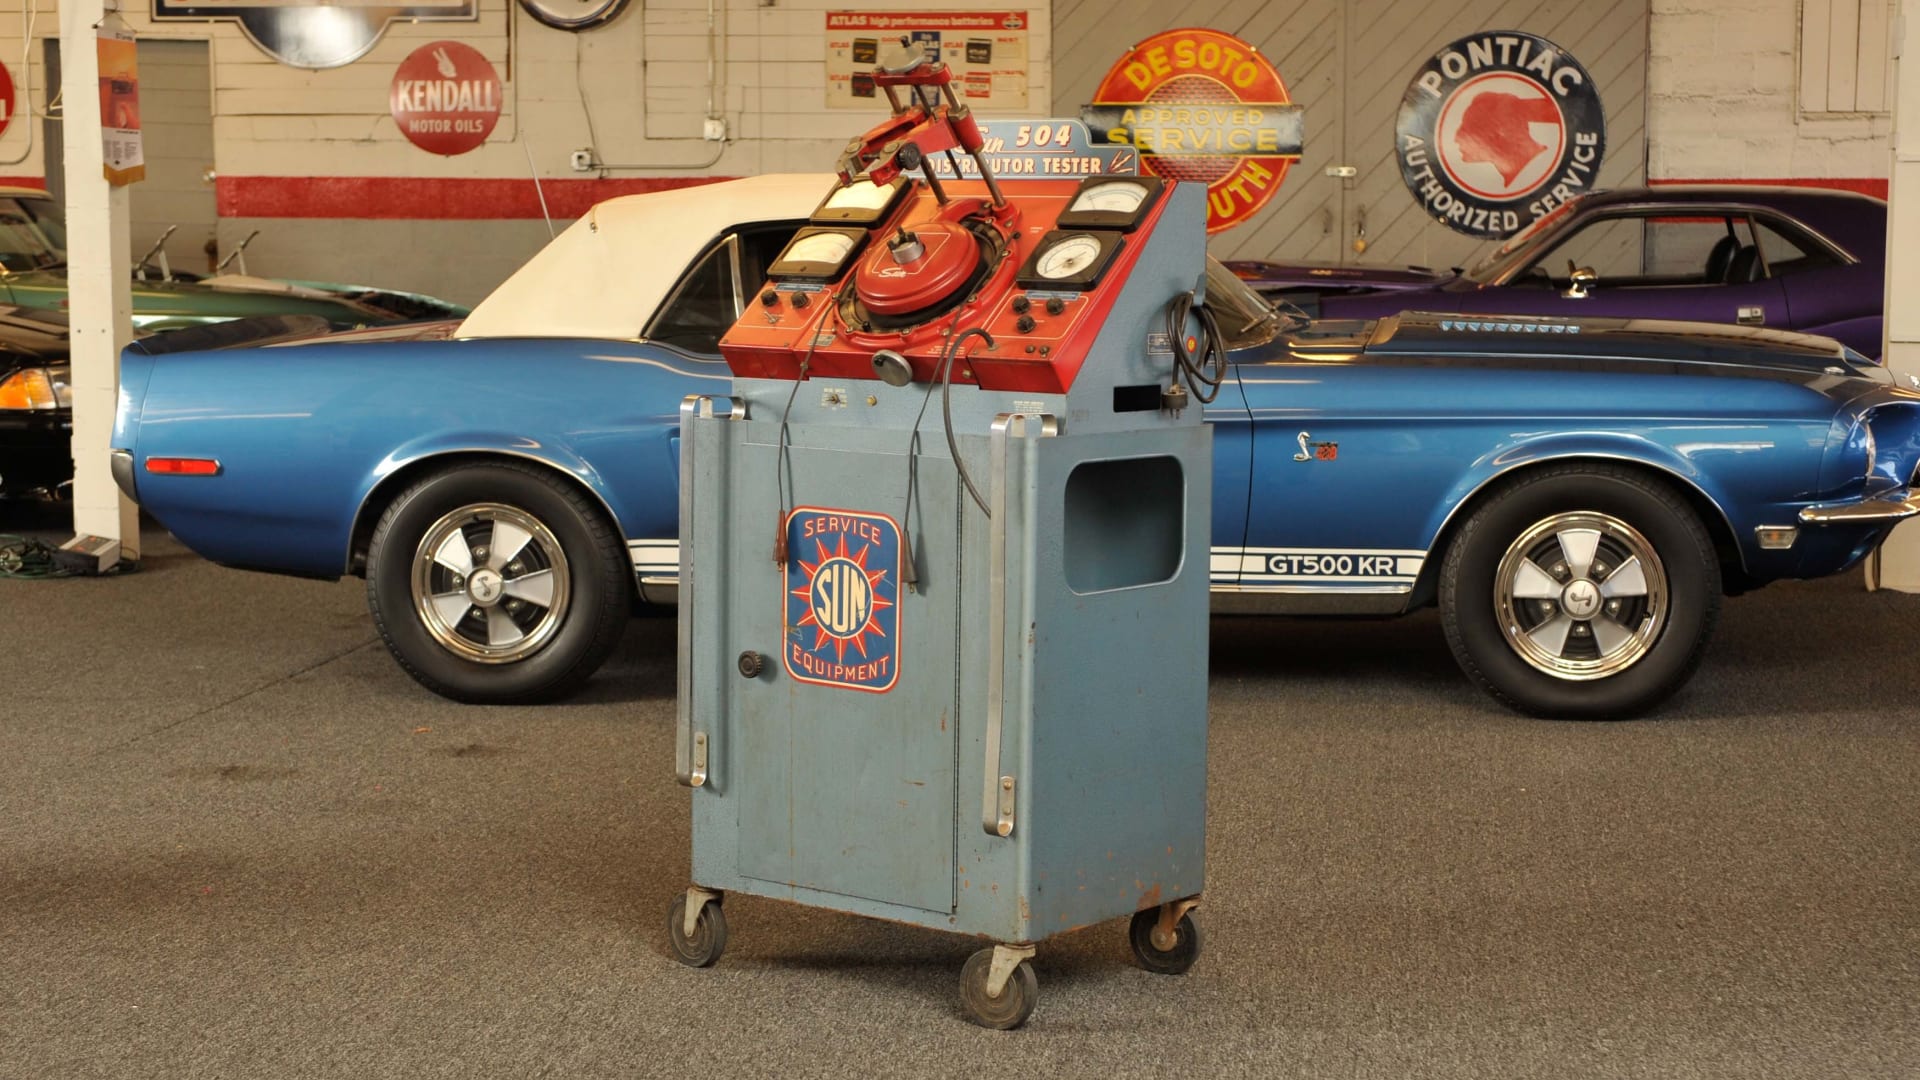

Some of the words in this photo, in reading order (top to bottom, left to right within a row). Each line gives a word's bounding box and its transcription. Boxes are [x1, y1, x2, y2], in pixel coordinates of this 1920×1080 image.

[829, 15, 868, 26] ATLAS
[1124, 46, 1173, 91] DE
[1173, 39, 1259, 89] SOTO
[1418, 36, 1583, 99] PONTIAC
[397, 79, 497, 113] KENDALL
[409, 119, 452, 133] MOTOR
[454, 119, 484, 133] OILS
[1121, 108, 1265, 126] APPROVED
[1016, 124, 1073, 148] 504
[1107, 127, 1278, 151] SERVICE
[1043, 157, 1102, 174] TESTER
[1404, 134, 1519, 232] AUTHORIZED
[1529, 131, 1598, 222] SERVICE
[804, 516, 882, 546] SERVICE
[1268, 555, 1353, 575] GT500
[1358, 556, 1394, 575] KR
[816, 563, 866, 634] SUN
[792, 642, 890, 681] EQUIPMENT
